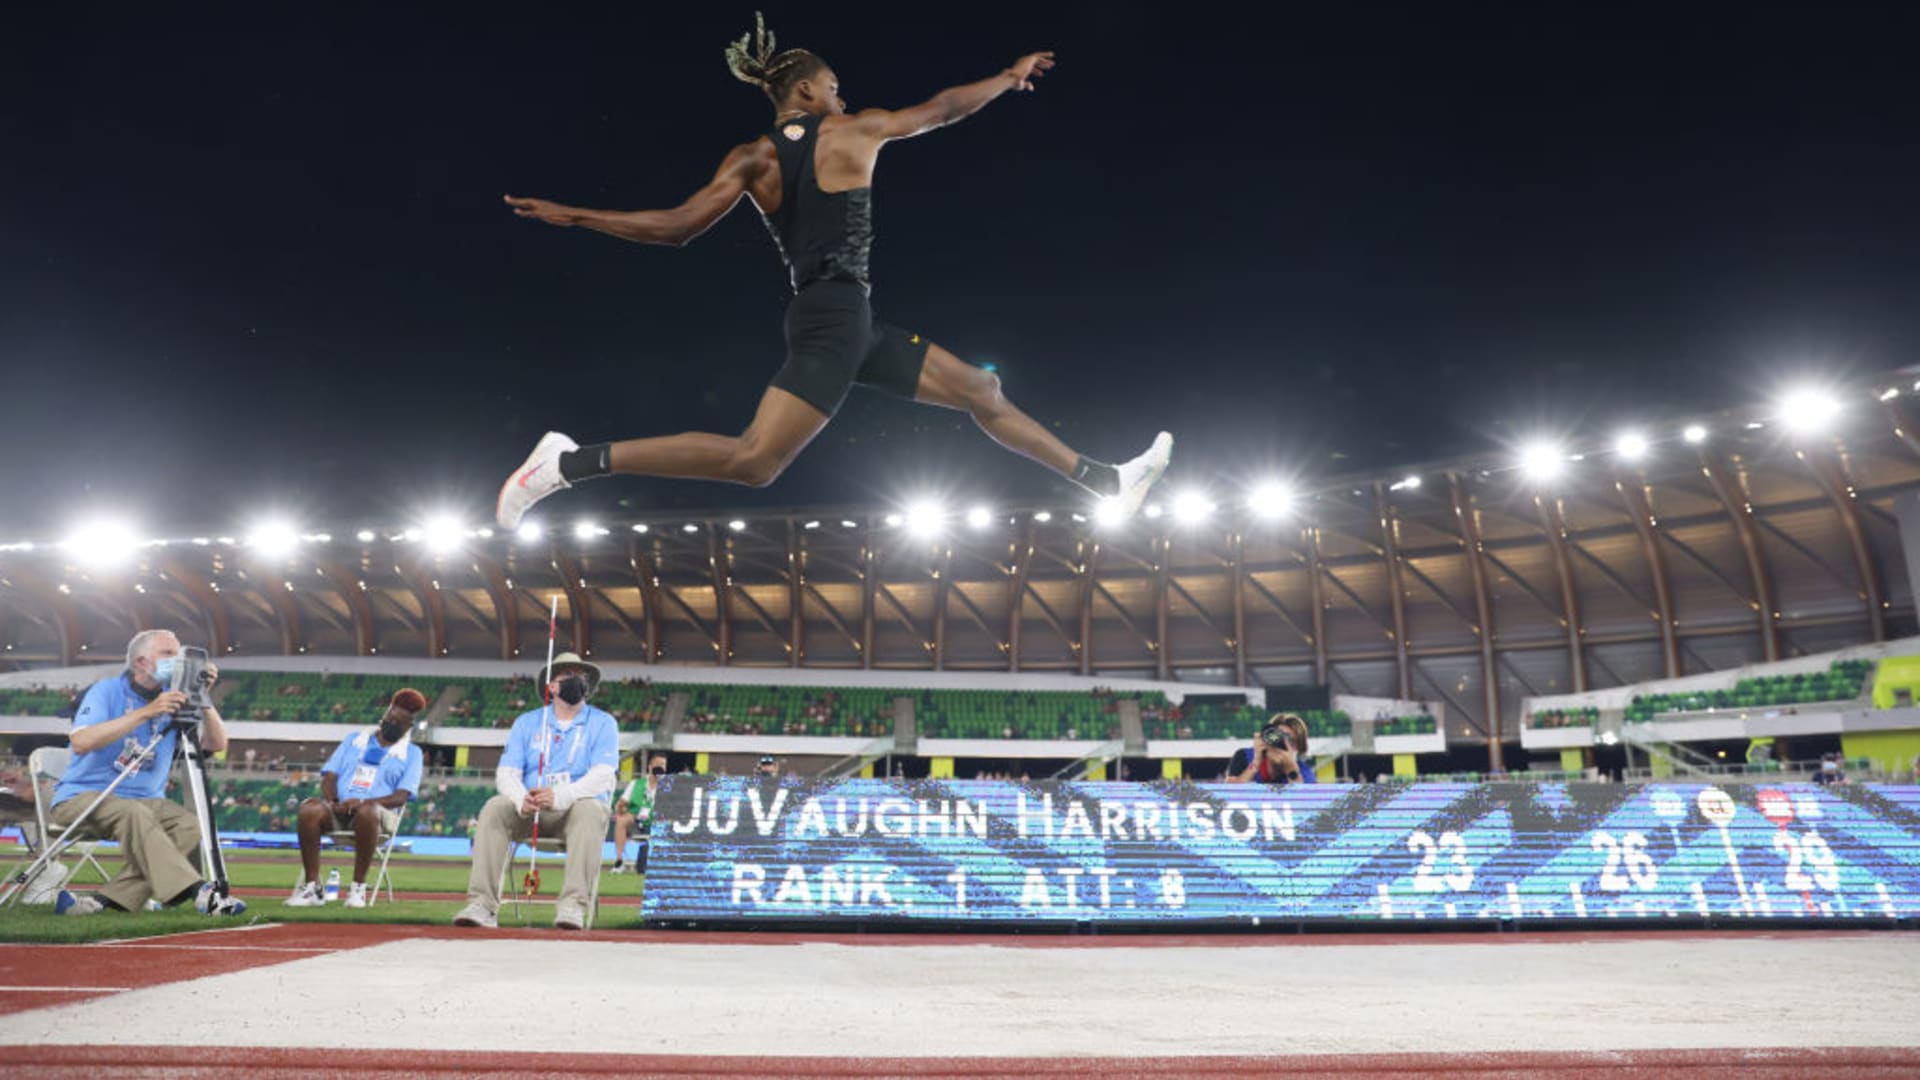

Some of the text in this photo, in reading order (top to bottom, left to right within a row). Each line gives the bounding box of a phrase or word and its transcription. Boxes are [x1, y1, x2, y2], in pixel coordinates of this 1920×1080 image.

[731, 863, 914, 908] RANK:
[948, 867, 969, 908] 1
[1021, 867, 1136, 908] ATT:
[1407, 830, 1841, 891] 23 26 29
